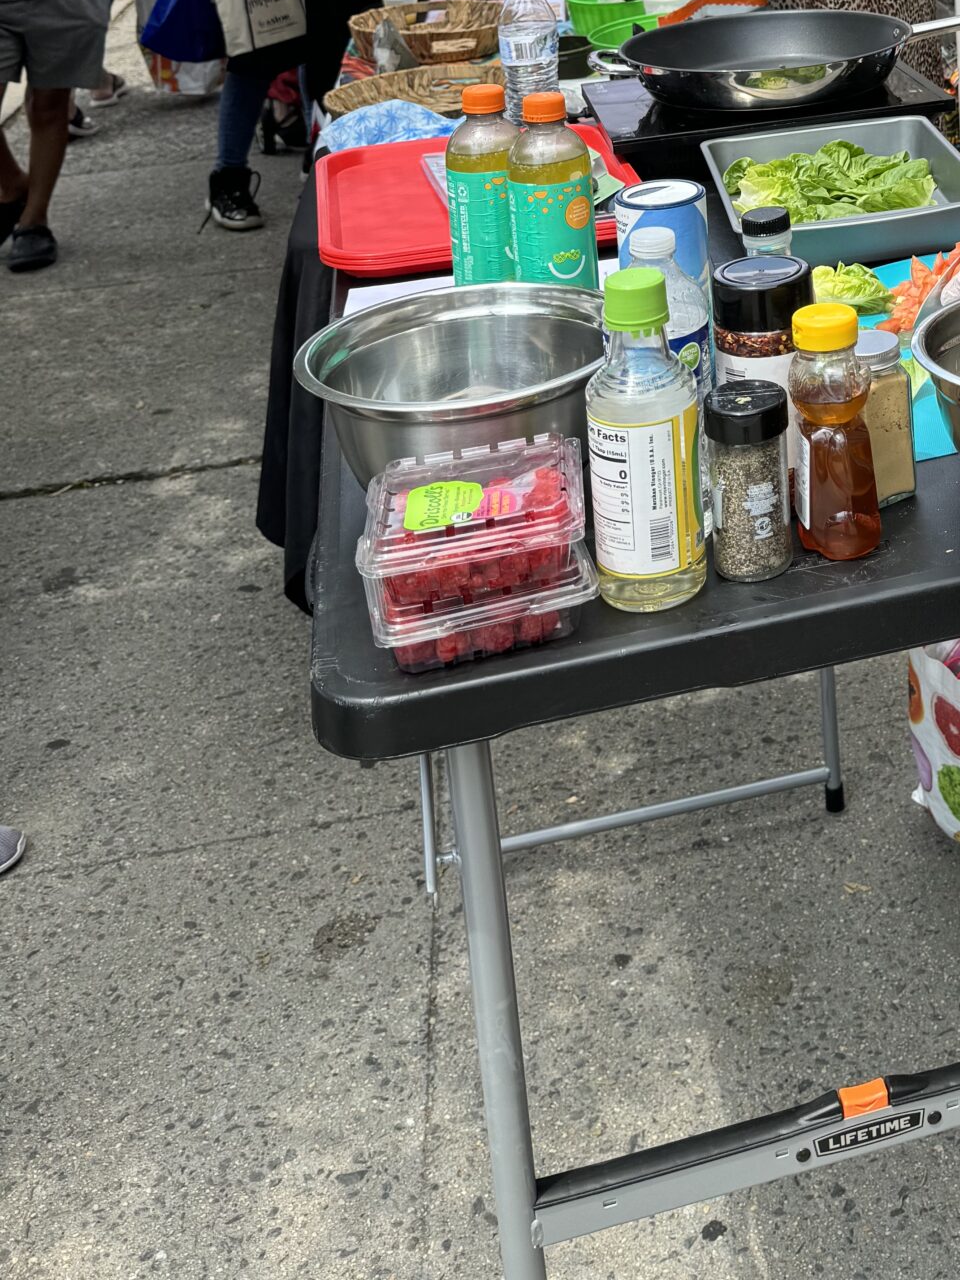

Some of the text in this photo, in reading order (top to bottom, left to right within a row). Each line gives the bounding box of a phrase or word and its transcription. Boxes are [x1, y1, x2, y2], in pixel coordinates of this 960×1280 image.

[597, 429, 626, 443] Facts
[619, 470, 628, 480] 0
[419, 485, 444, 527] Driscoll's
[828, 1116, 911, 1150] LIFETIME
